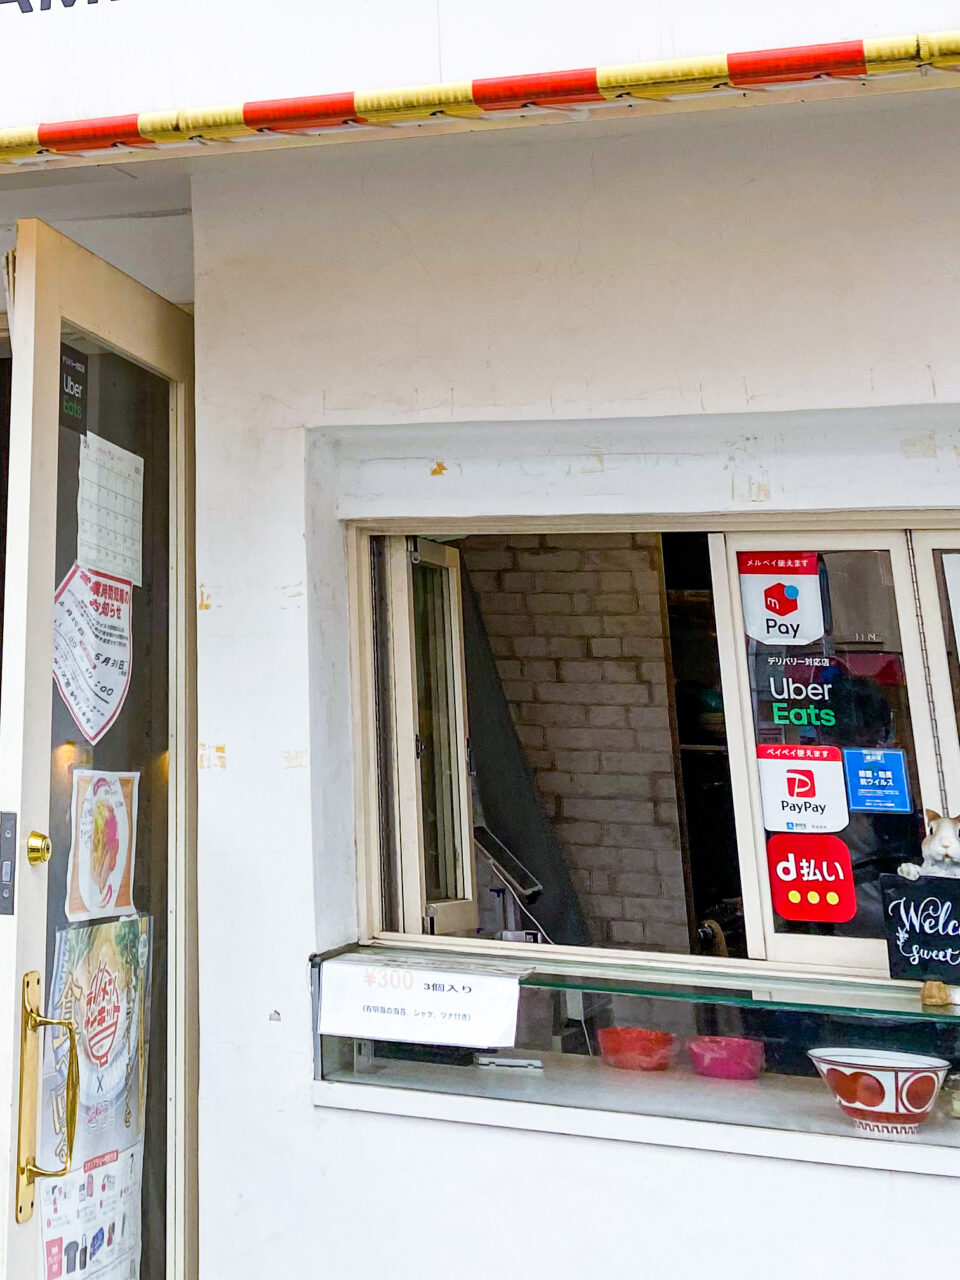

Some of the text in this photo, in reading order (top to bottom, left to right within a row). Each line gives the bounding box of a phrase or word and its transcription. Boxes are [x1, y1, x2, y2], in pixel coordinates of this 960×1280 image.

[63, 373, 83, 399] Uber
[63, 395, 83, 419] Eats
[746, 559, 809, 567] メルペイ使えます
[765, 618, 801, 639] Pay
[767, 657, 830, 667] デリバリー対応店
[769, 677, 833, 700] Uber
[772, 702, 837, 726] Eats
[766, 748, 829, 758] ペイペイ使えます
[781, 800, 827, 815] PayPay
[776, 852, 845, 882] d払い
[888, 896, 960, 936] Welc
[363, 967, 414, 991] ¥300
